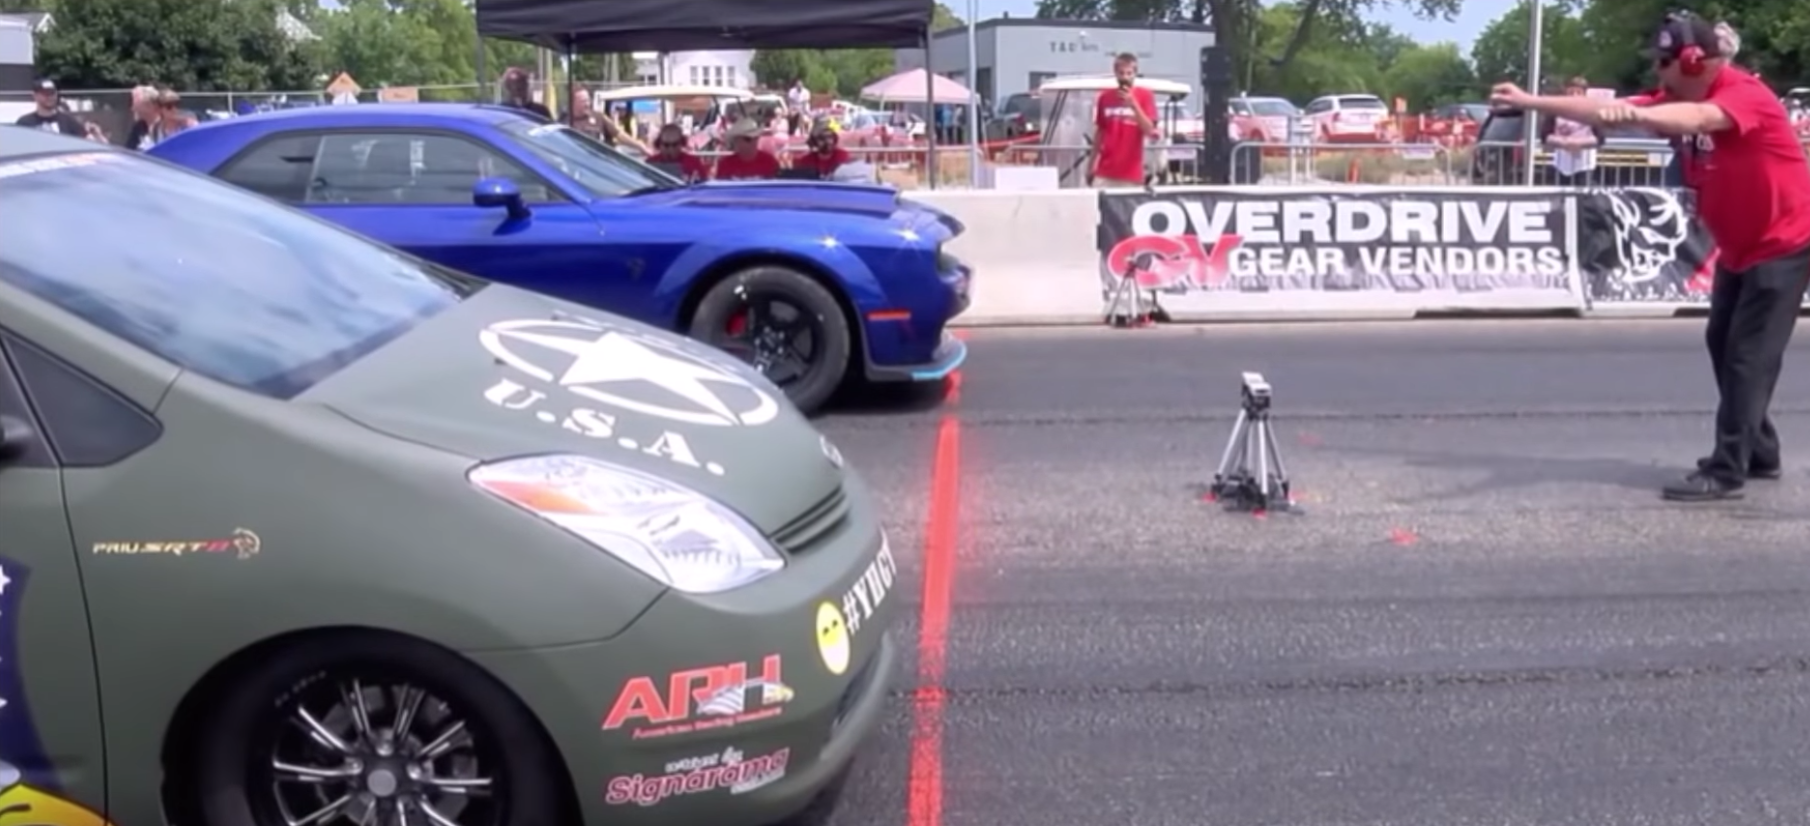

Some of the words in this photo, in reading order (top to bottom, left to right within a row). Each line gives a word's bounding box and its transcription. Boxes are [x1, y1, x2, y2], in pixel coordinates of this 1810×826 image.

[1132, 200, 1553, 243] OVERDRIVE
[1228, 247, 1346, 276] GEAR
[1358, 246, 1564, 276] VENDORS
[484, 377, 726, 477] U.S.A.
[605, 747, 790, 806] Signarama
